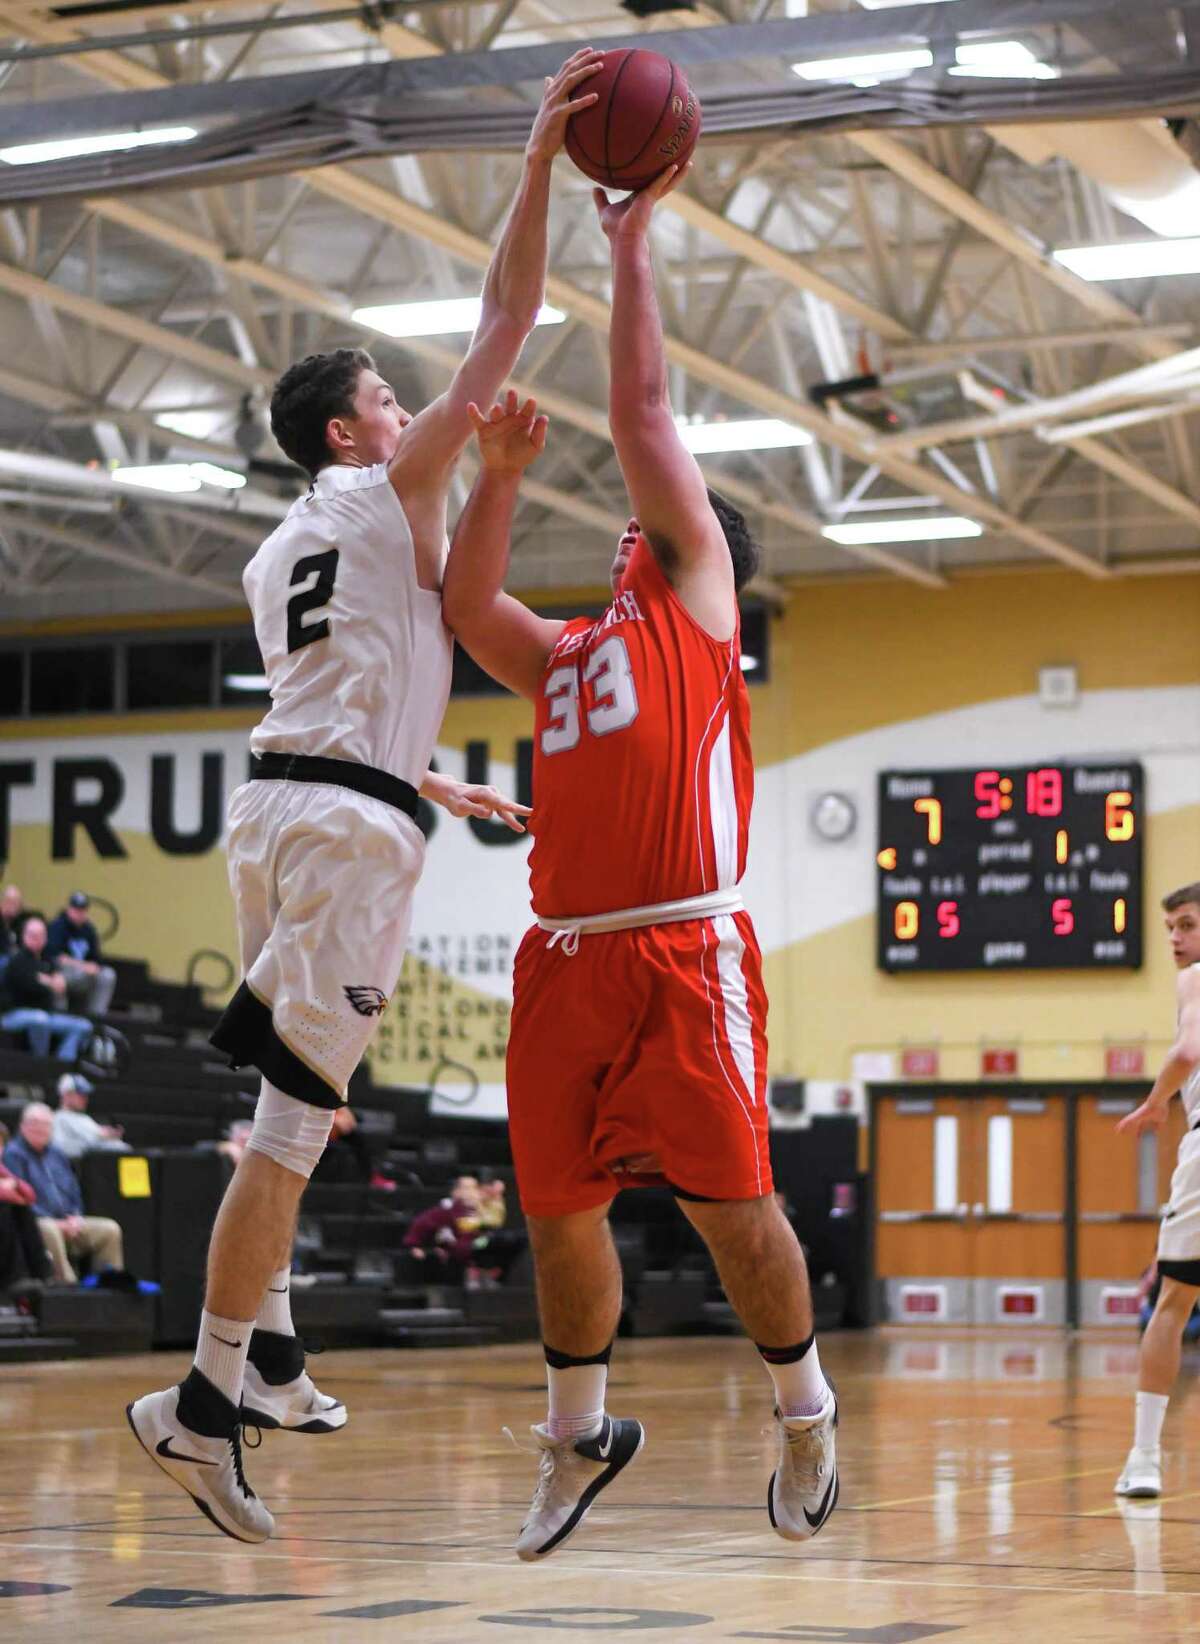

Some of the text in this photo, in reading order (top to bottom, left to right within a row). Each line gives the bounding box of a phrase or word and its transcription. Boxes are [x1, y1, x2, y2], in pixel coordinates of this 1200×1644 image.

[287, 548, 339, 655] 2
[541, 635, 640, 757] 33
[914, 791, 1134, 845] 7 6
[974, 768, 1063, 820] 5:18
[1056, 829, 1068, 865] 1
[408, 934, 511, 953] ATION
[895, 898, 1126, 940] 0 5 5 1
